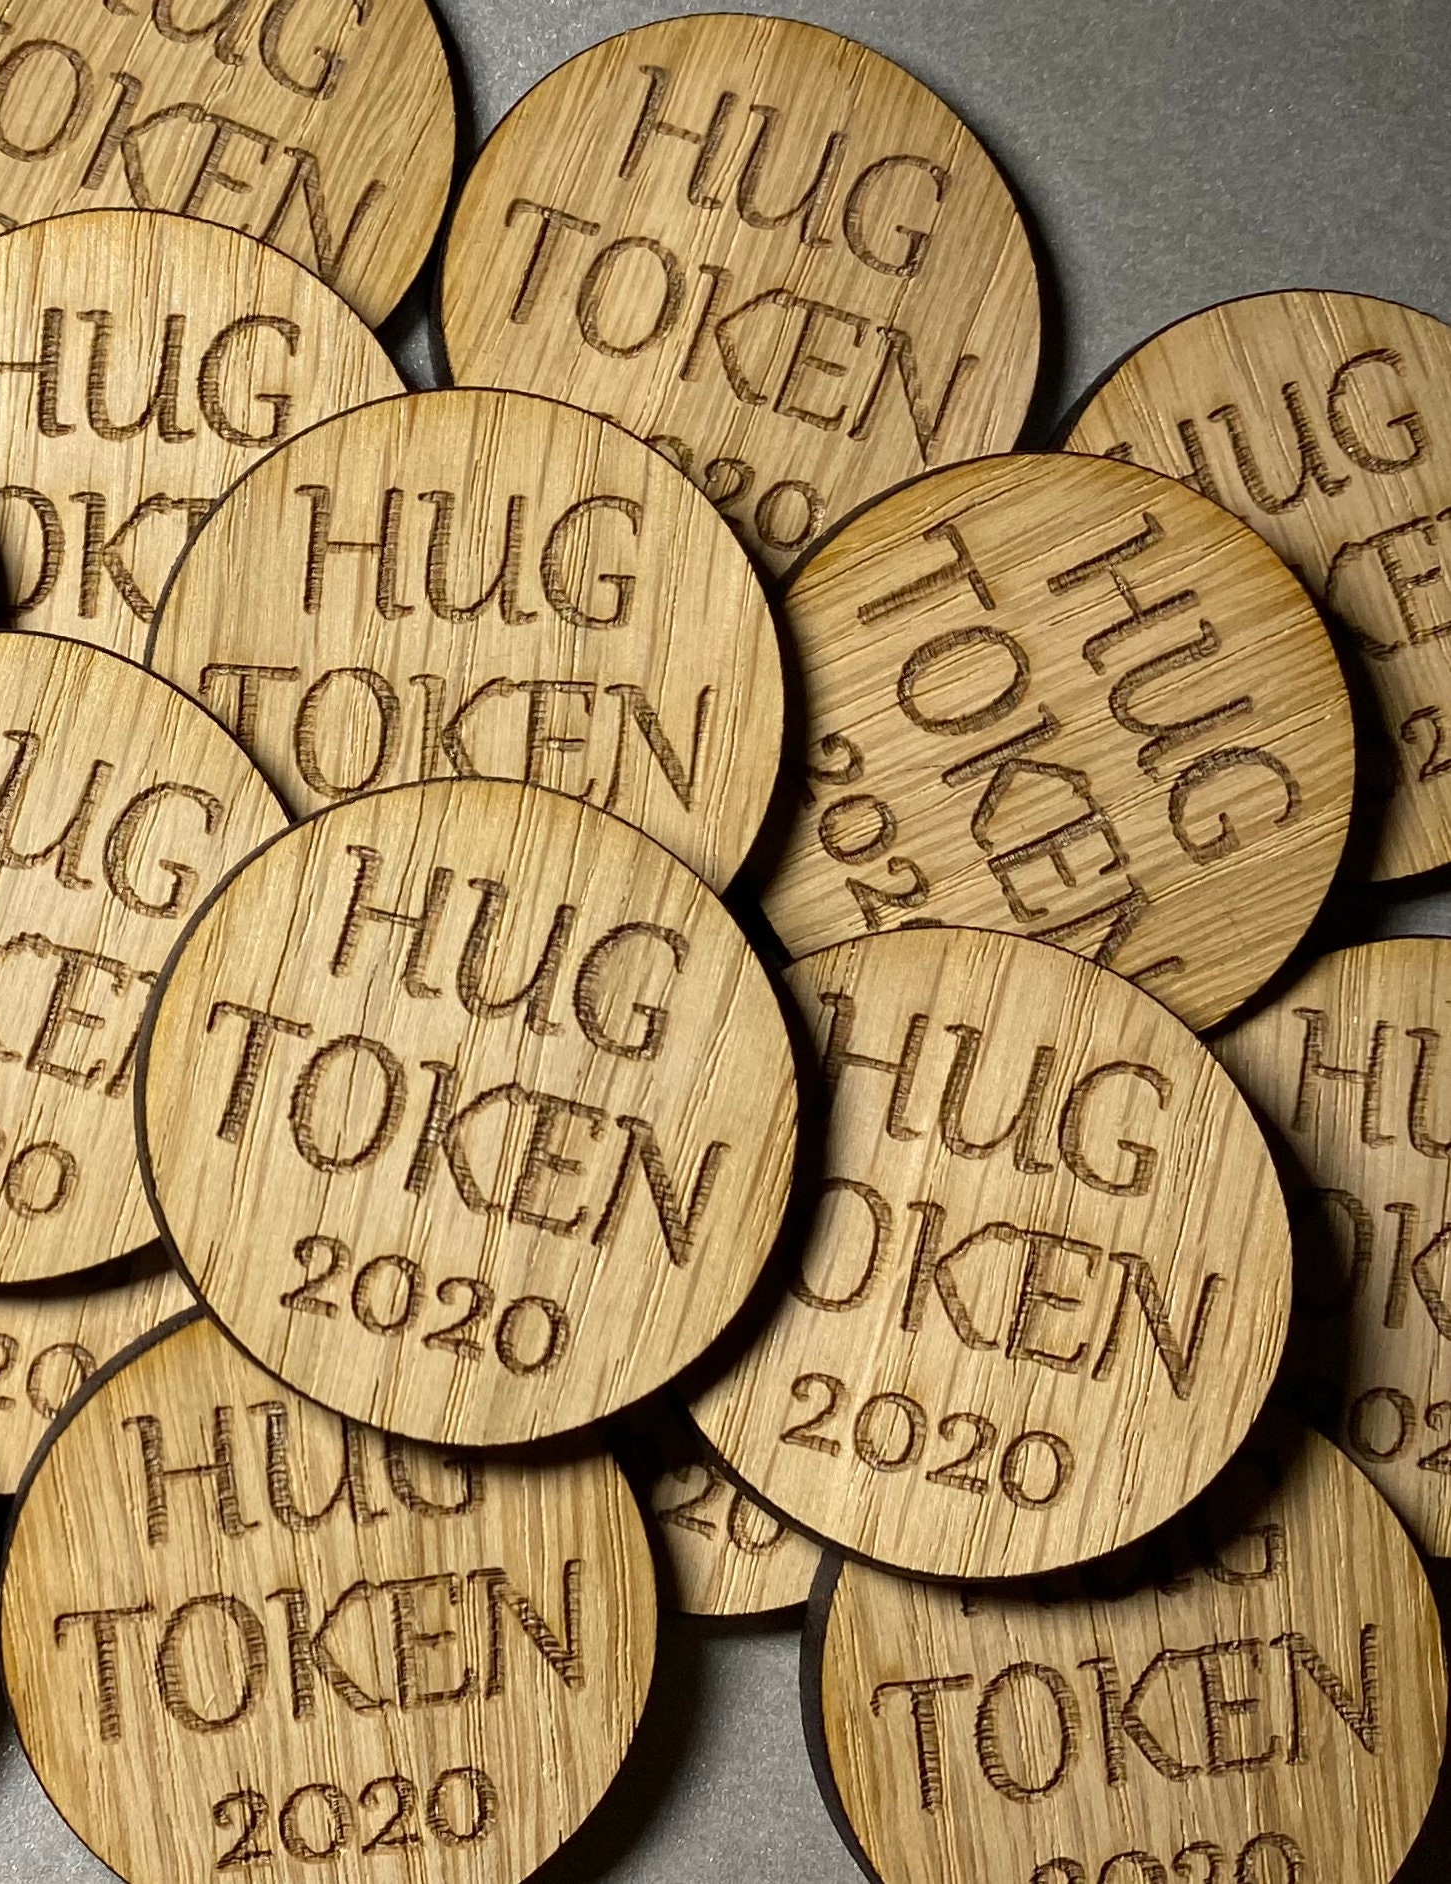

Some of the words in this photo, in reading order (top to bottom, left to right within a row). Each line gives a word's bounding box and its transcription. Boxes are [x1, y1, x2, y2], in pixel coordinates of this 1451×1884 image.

[616, 64, 952, 278] HUG
[504, 199, 980, 467] TOKEN
[295, 484, 644, 630] HUG
[198, 664, 720, 813] TOKEN
[1048, 511, 1303, 867] HUG
[802, 733, 946, 931] 202
[330, 843, 692, 1063] HUG
[205, 1000, 732, 1270] TOKEN
[817, 990, 1175, 1198] HUG
[280, 1234, 571, 1378] 2020
[788, 1176, 1227, 1402] OKEN
[779, 1371, 1074, 1511] 2020
[53, 1558, 586, 1745] TOKEN
[869, 1622, 1382, 1815] TOKEN
[212, 1766, 499, 1871] 2020
